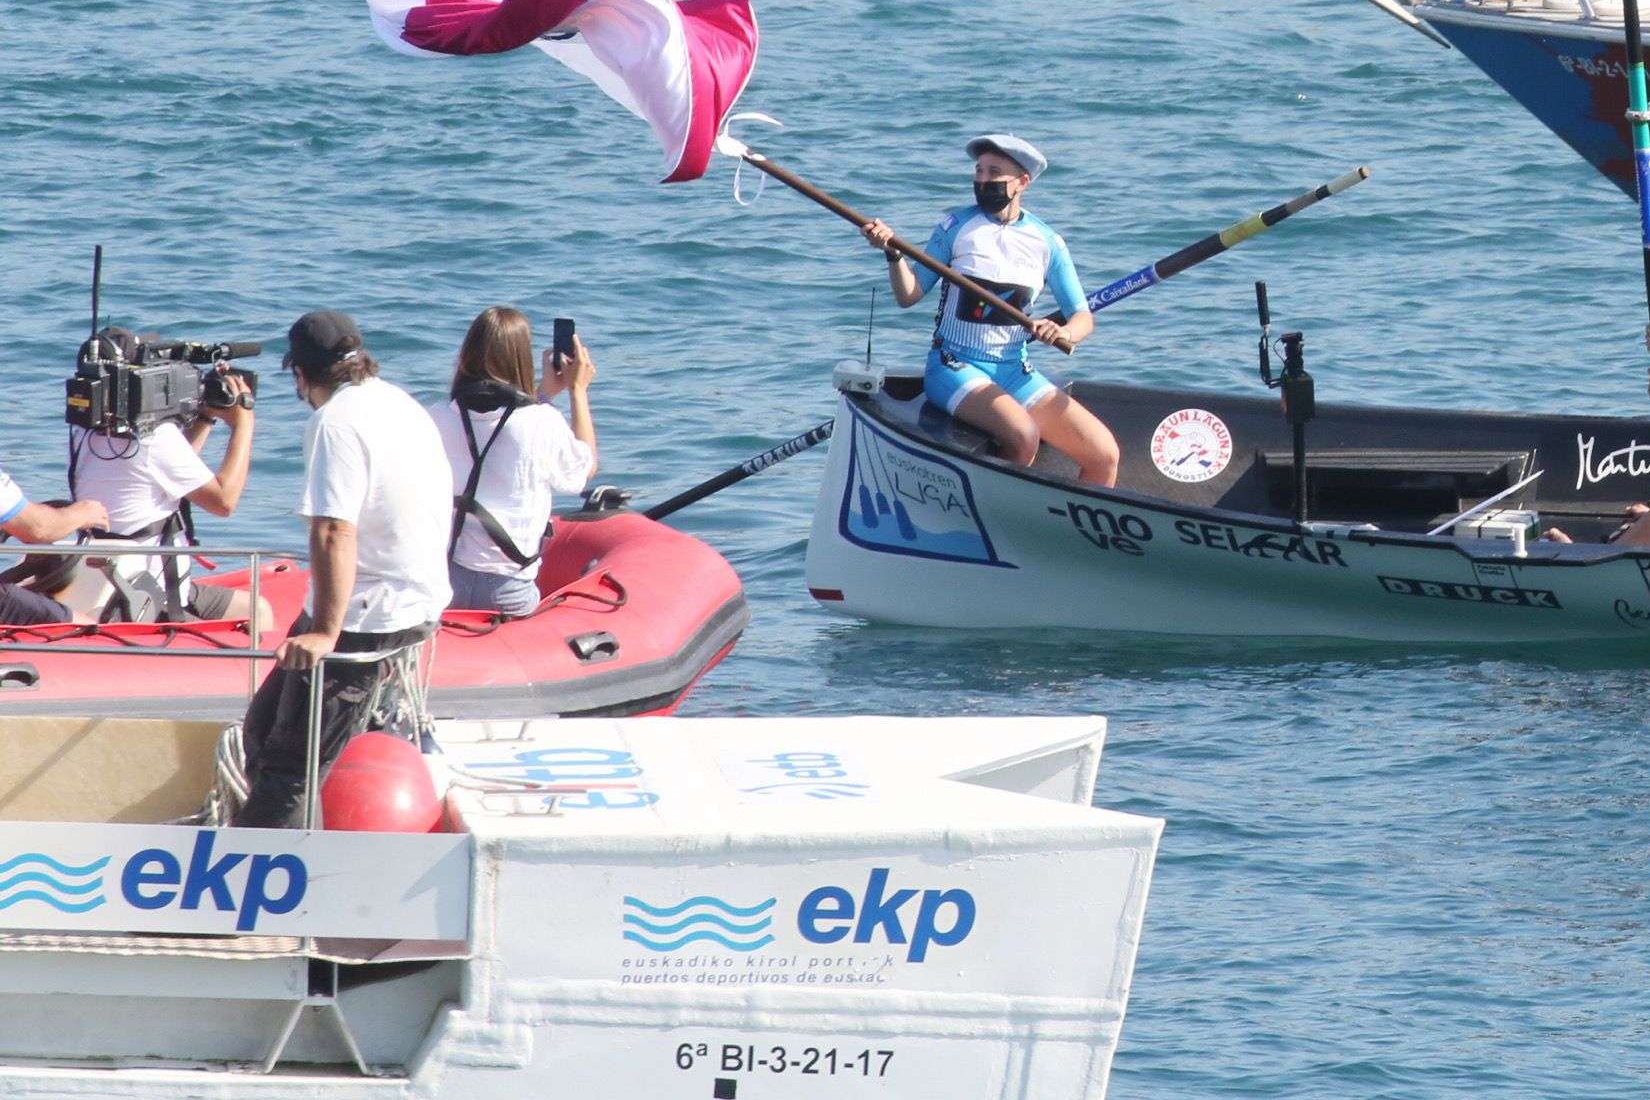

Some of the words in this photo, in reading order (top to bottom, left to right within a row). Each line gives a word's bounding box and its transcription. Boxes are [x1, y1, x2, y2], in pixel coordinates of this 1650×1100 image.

[1100, 274, 1150, 303] CaixaBank
[886, 452, 957, 490] euskotren
[895, 472, 970, 518] LIGA
[1384, 578, 1557, 608] DRUCK
[121, 830, 308, 932] ekp
[797, 868, 976, 963] ekp
[621, 956, 734, 969] euskadiko
[745, 955, 798, 968] kirol
[621, 971, 690, 985] puertos
[695, 971, 790, 985] deportivos
[796, 972, 818, 985] de
[721, 1045, 896, 1078] BI-3-21-17
